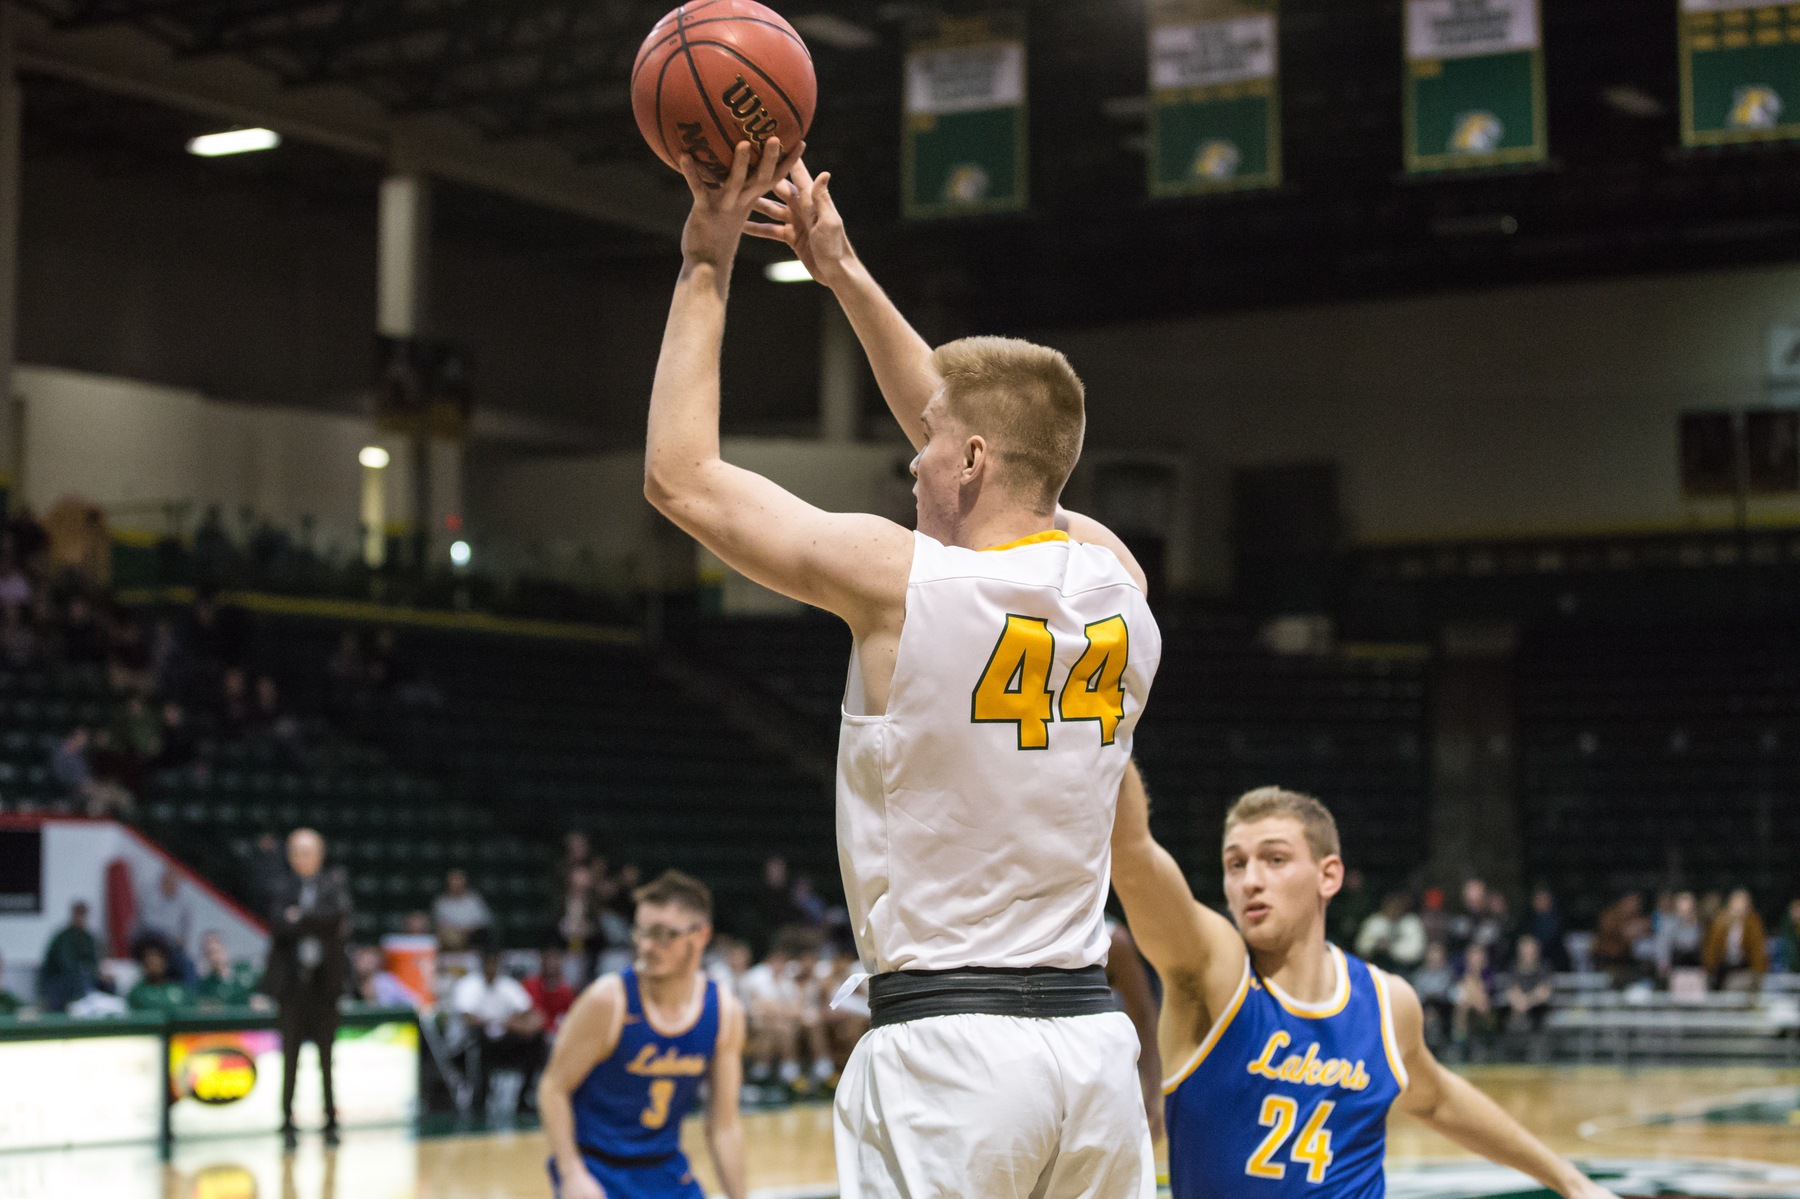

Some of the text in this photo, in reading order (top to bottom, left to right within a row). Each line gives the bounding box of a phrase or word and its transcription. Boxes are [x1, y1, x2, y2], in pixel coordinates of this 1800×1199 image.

[721, 73, 781, 153] Wil
[971, 613, 1128, 750] 44
[1246, 1029, 1371, 1091] Lakers
[641, 1079, 675, 1129] 3
[1244, 1093, 1336, 1184] 24
